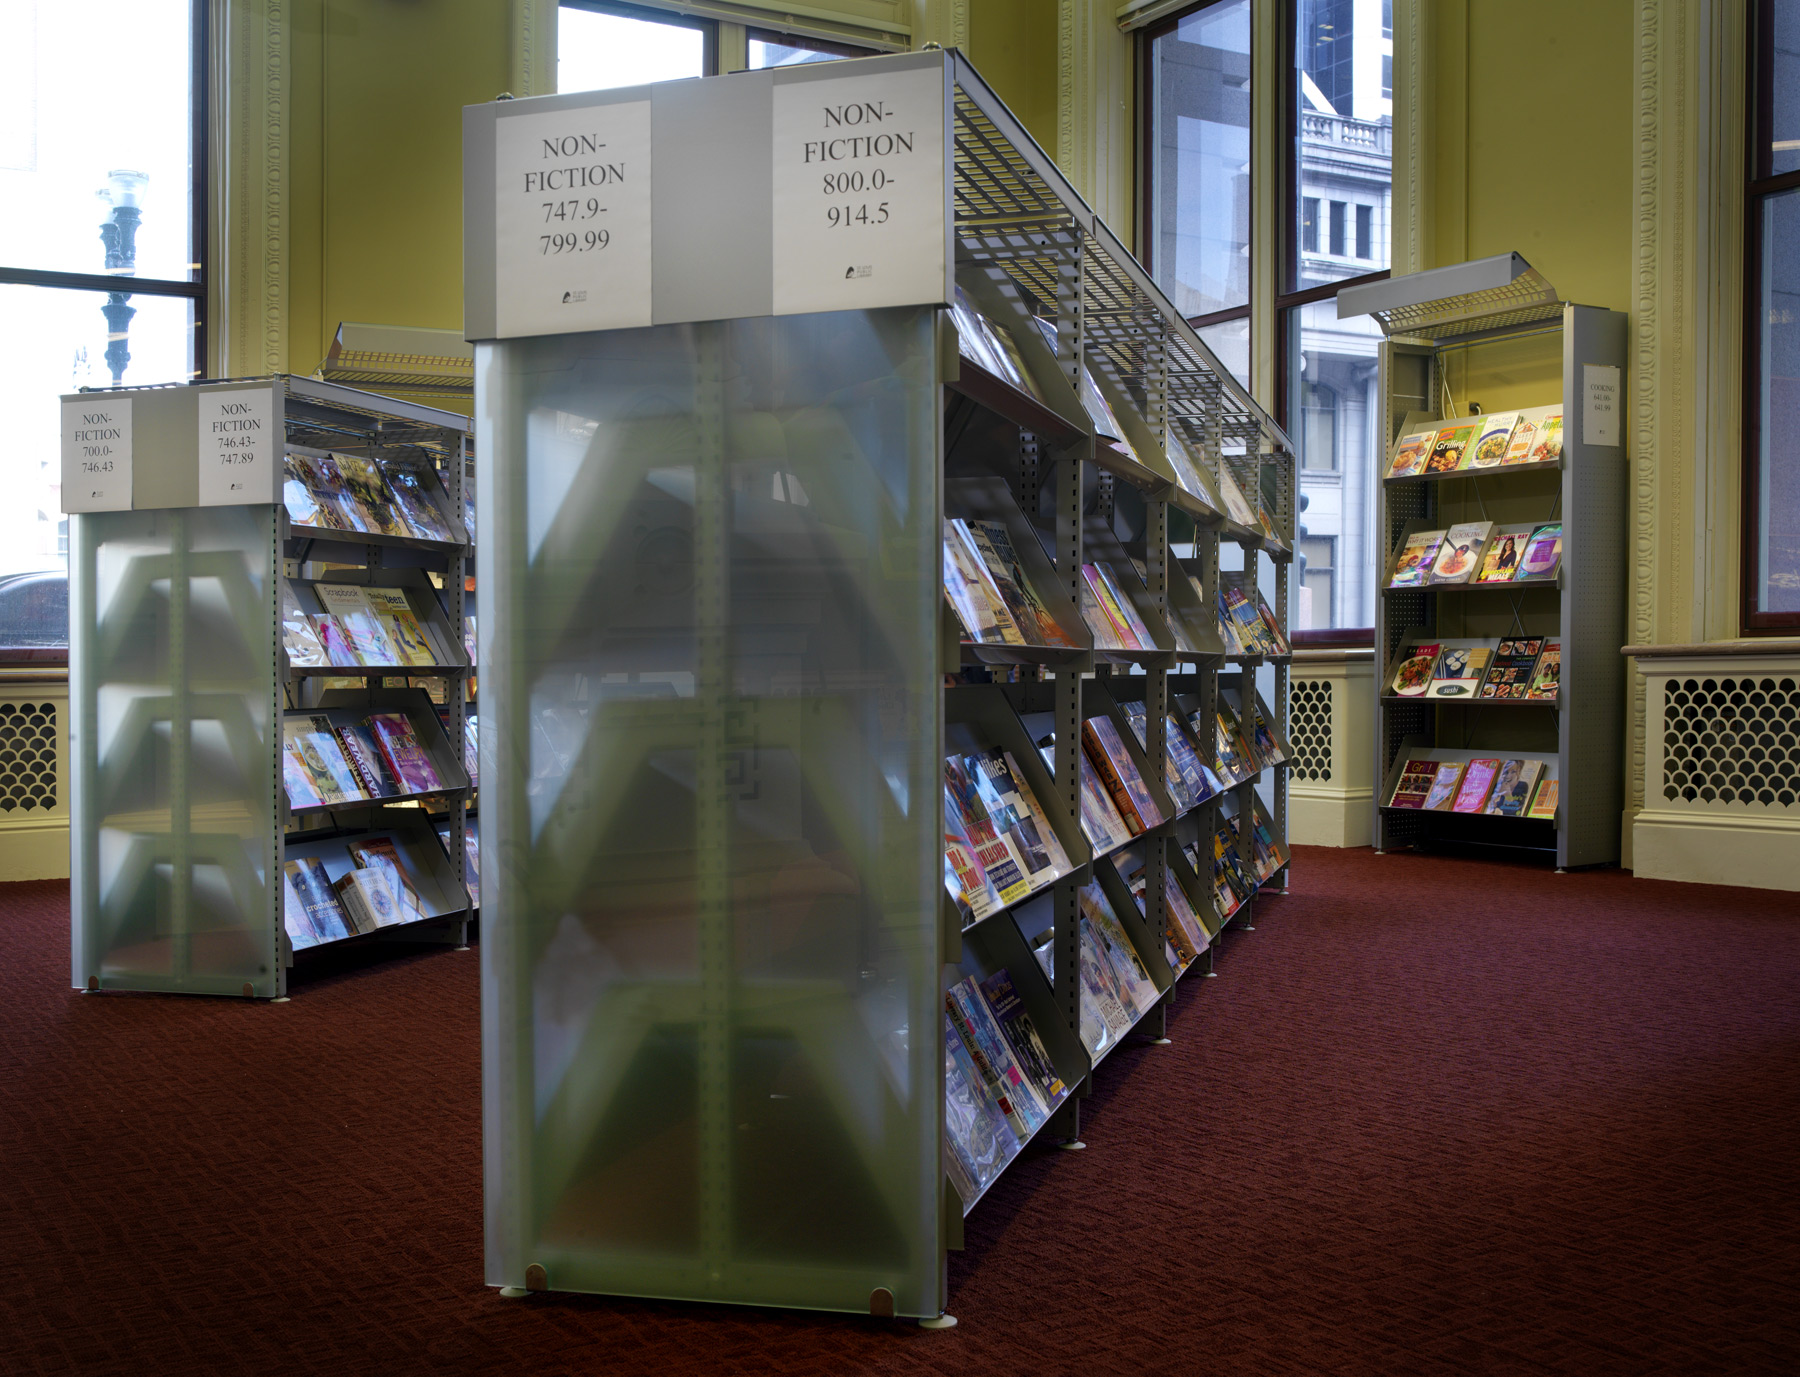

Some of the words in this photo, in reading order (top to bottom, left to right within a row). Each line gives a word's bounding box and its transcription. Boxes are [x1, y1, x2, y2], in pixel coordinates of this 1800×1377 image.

[823, 101, 894, 128] NON-
[542, 133, 606, 160] NON-
[803, 132, 915, 163] FICTION
[524, 163, 626, 193] FICTION
[823, 169, 895, 195] 800.0-
[542, 197, 608, 224] 747.9-
[827, 202, 890, 229] 914.5
[539, 229, 610, 256] 799.99
[1590, 384, 1615, 392] COOKING
[221, 403, 252, 416] NON-
[83, 413, 112, 425] NON-
[212, 419, 261, 433] FICTION
[75, 428, 121, 442] FICTION
[218, 436, 255, 449] 746.43-
[1436, 439, 1467, 450] Grilling
[83, 445, 112, 457] 700.0-
[220, 452, 254, 465] 747.89
[82, 461, 114, 473] 746.43
[1451, 531, 1483, 540] COOKING
[323, 586, 359, 597] Scrapbook
[385, 594, 405, 605] teen
[1443, 685, 1460, 694] sushi
[1081, 726, 1101, 759] WORLD
[1100, 759, 1114, 779] WAR
[1108, 778, 1122, 794] Z
[306, 899, 339, 912] crocheted
[946, 995, 959, 1022] Literary
[962, 1030, 975, 1050] Louis:
[976, 1056, 991, 1075] Guide
